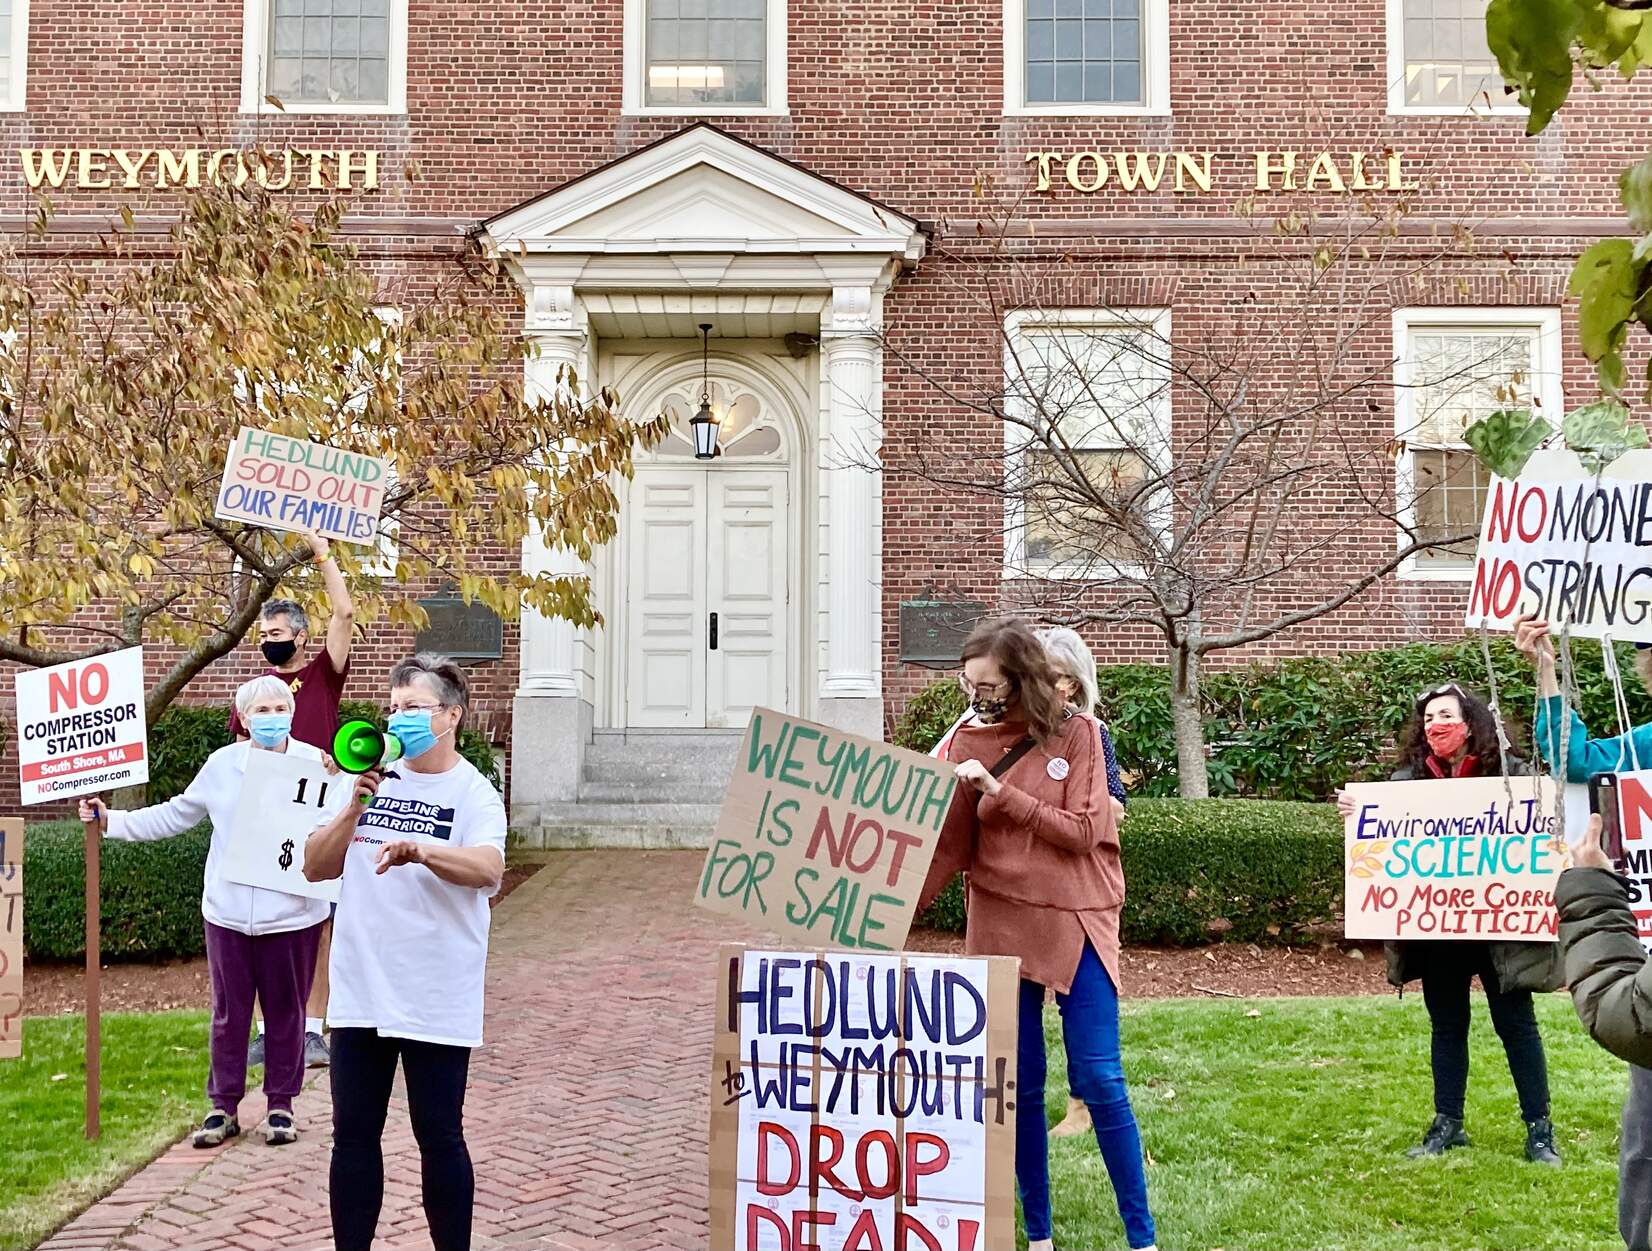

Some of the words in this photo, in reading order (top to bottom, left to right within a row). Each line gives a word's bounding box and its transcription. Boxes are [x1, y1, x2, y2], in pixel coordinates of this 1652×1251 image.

[19, 148, 381, 190] WEYMOUTH
[1026, 151, 1214, 192] TOWN
[1254, 151, 1419, 191] HALL
[244, 430, 381, 482] HEDLUND
[223, 484, 276, 518] OUR
[236, 458, 311, 492] SOLD
[317, 476, 379, 508] OUT
[1488, 481, 1548, 543] NO
[1470, 557, 1521, 619] NO
[1520, 558, 1652, 626] STRING
[48, 662, 109, 713] NO
[24, 703, 137, 741] COMPRESSOR
[47, 726, 116, 755] STATION
[38, 769, 131, 794] NOCompressor.com
[40, 761, 71, 775] South
[73, 753, 107, 771] Shore,
[109, 749, 126, 762] MA
[748, 715, 956, 831] WEYMOUTH
[366, 814, 436, 835] WARRIOR
[374, 798, 441, 818] PIPELINE
[756, 790, 800, 846] IS
[805, 806, 923, 887] NOT
[1385, 835, 1553, 878] SCIENCE
[701, 839, 775, 916] FOR
[785, 867, 905, 950] SALE
[1361, 884, 1398, 912] NO
[728, 957, 986, 1045] HEDLUND
[720, 1060, 745, 1095] to
[757, 1122, 950, 1206] DROP
